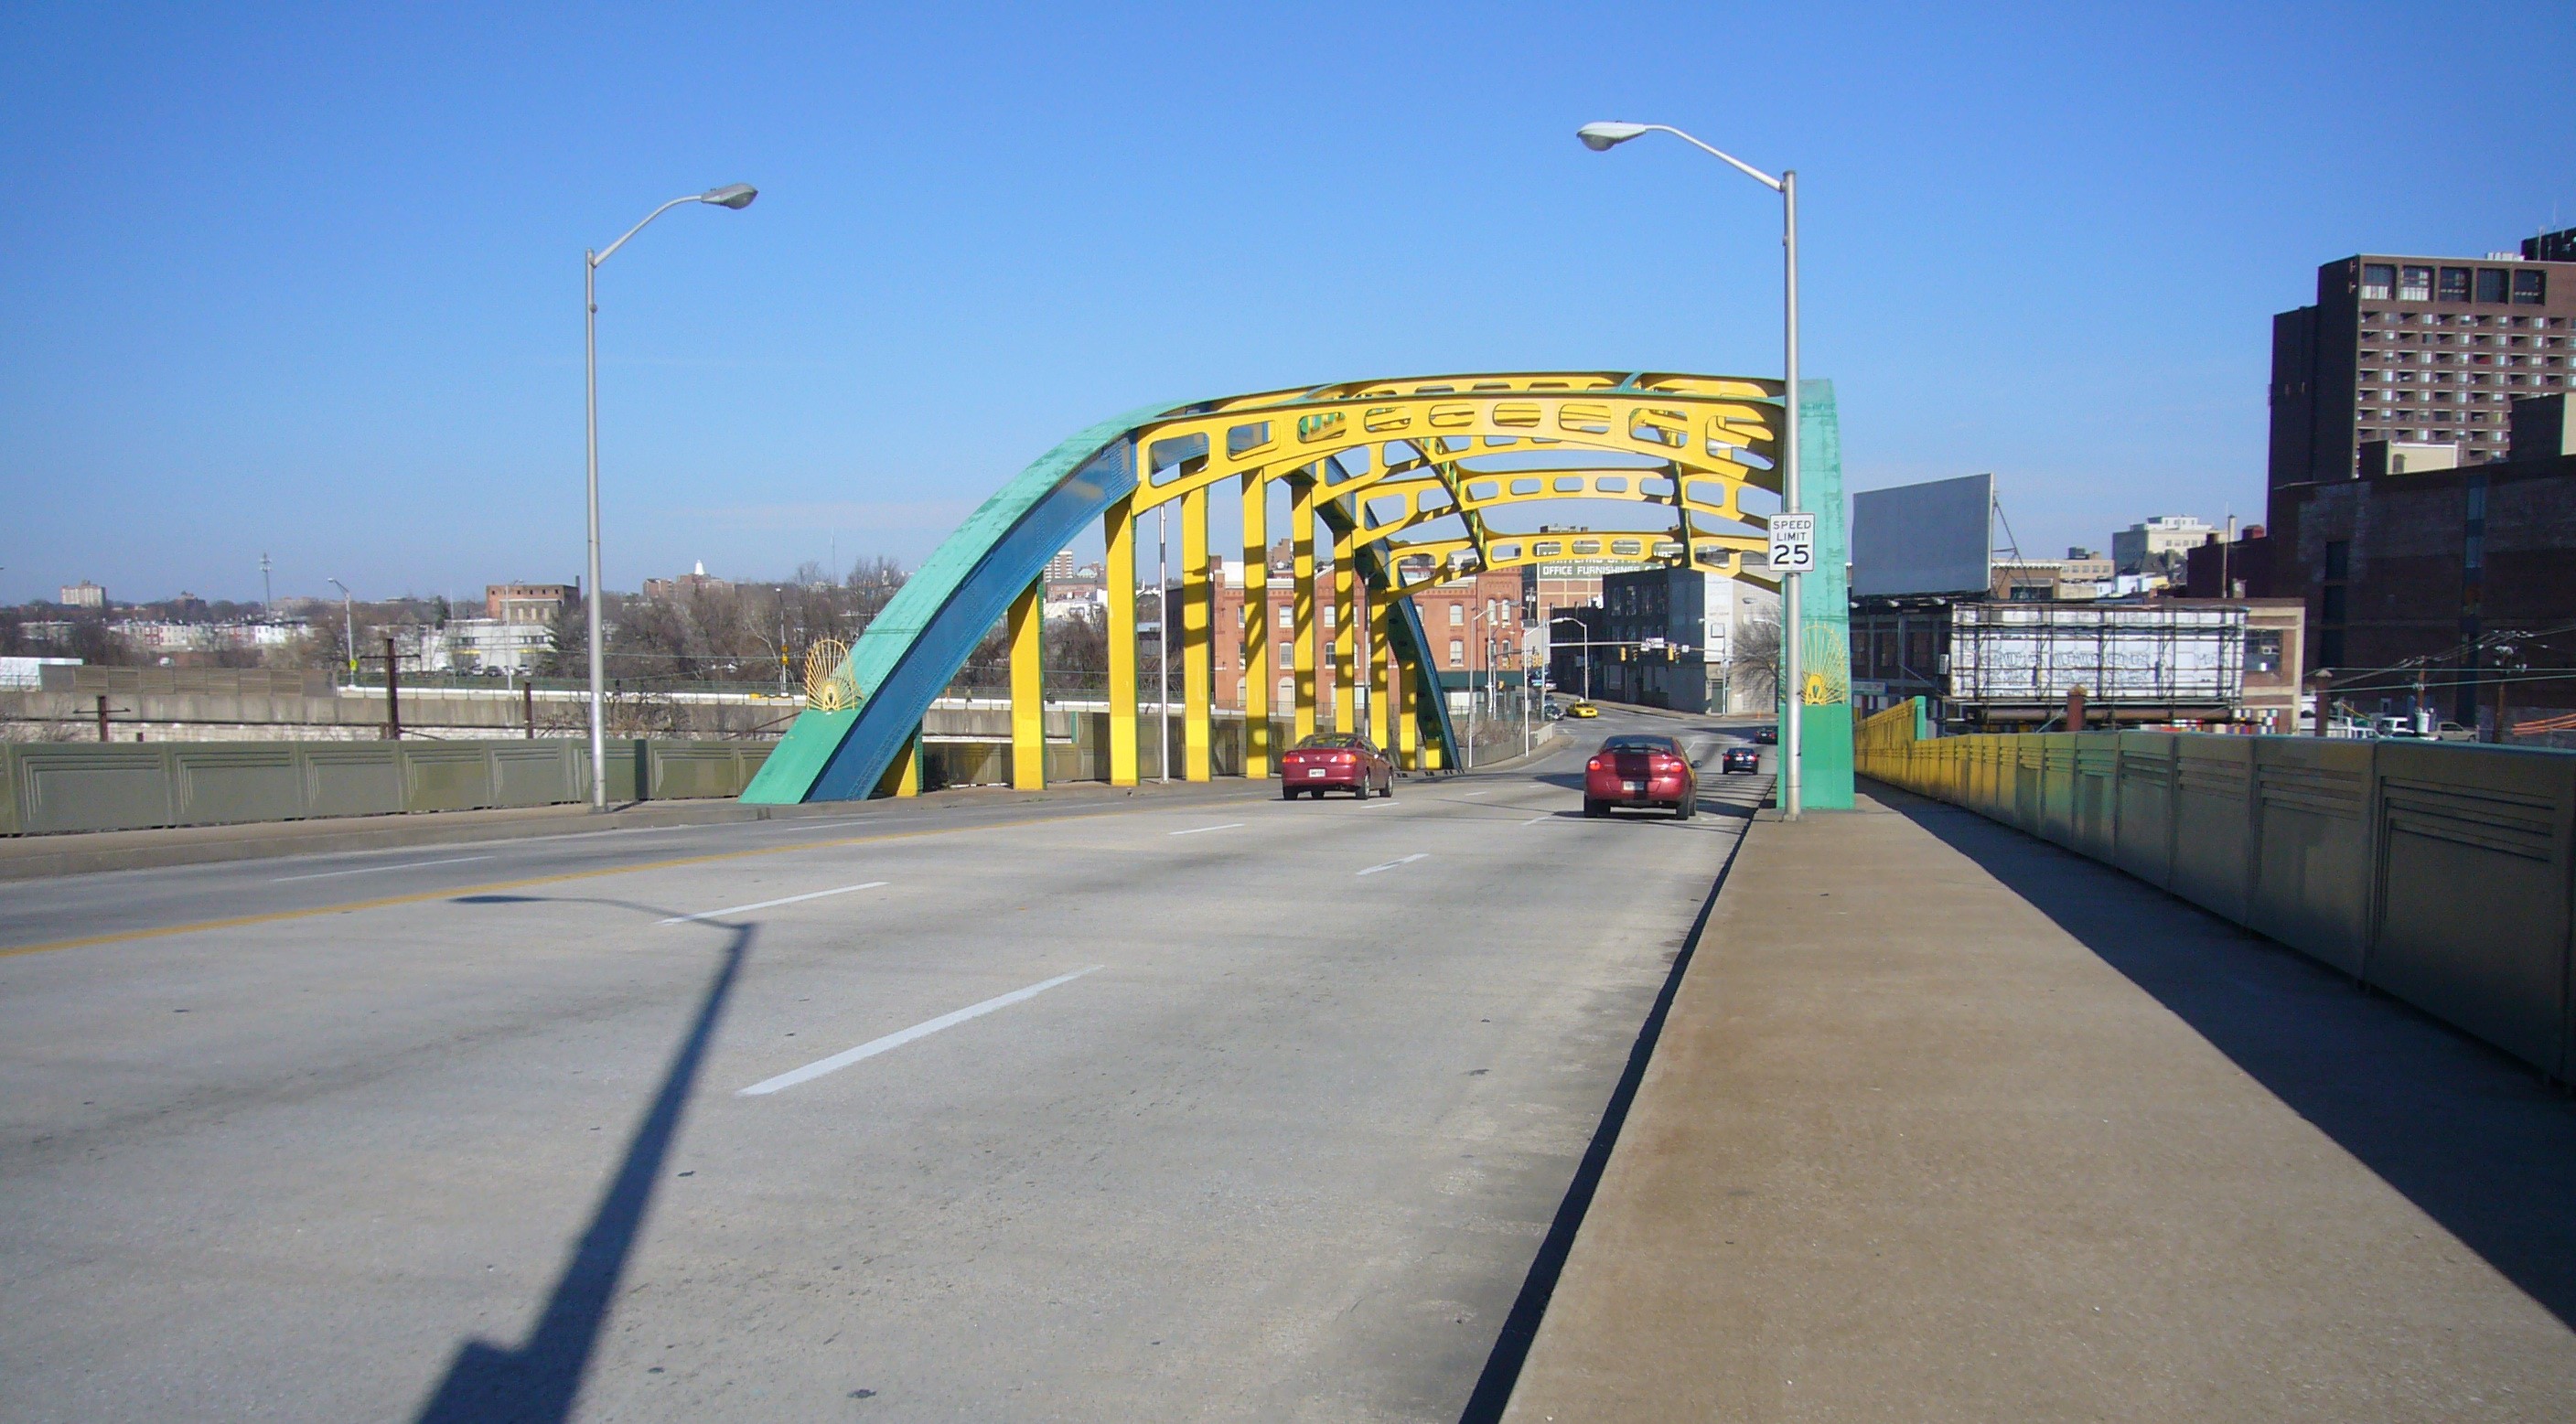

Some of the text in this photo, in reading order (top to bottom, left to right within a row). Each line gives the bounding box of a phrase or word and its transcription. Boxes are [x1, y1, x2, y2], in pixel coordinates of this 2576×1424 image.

[1773, 520, 1811, 530] SPEED
[1776, 532, 1807, 541] LIMIT
[1774, 544, 1809, 564] 25
[1542, 565, 1572, 575] OFFICE
